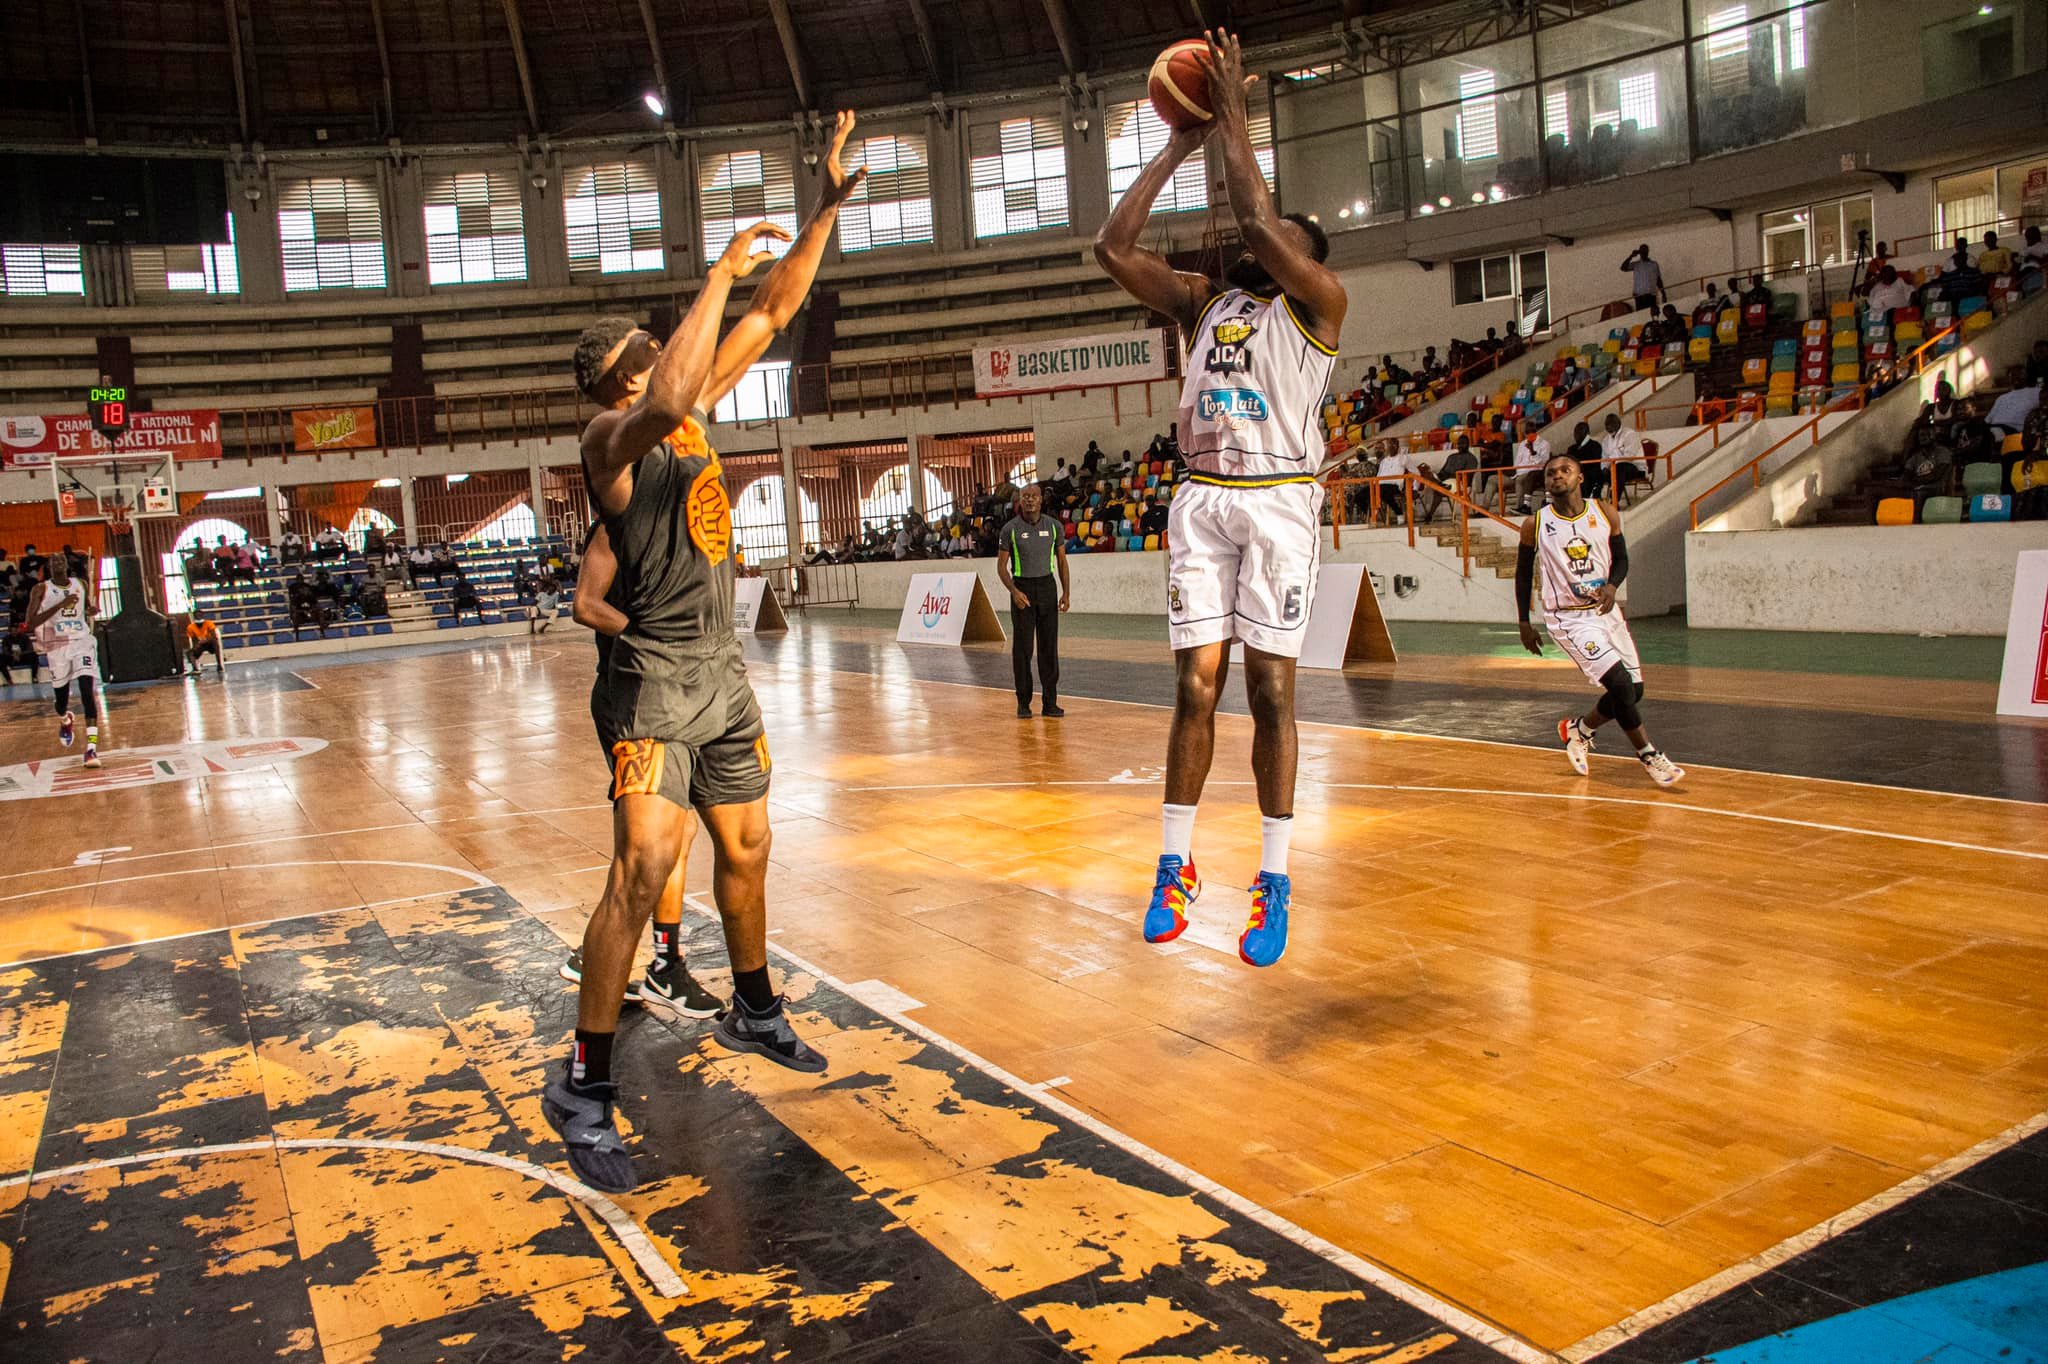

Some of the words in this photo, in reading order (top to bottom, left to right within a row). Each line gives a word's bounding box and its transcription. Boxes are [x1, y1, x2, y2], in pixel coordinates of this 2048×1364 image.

[1210, 345, 1246, 366] JCA
[90, 388, 125, 401] 04:20
[103, 403, 124, 425] 18
[141, 415, 195, 431] NATIONAL
[58, 433, 81, 450] DE
[1570, 559, 1592, 572] JCA
[918, 591, 951, 615] Awa
[1283, 585, 1301, 621] 6
